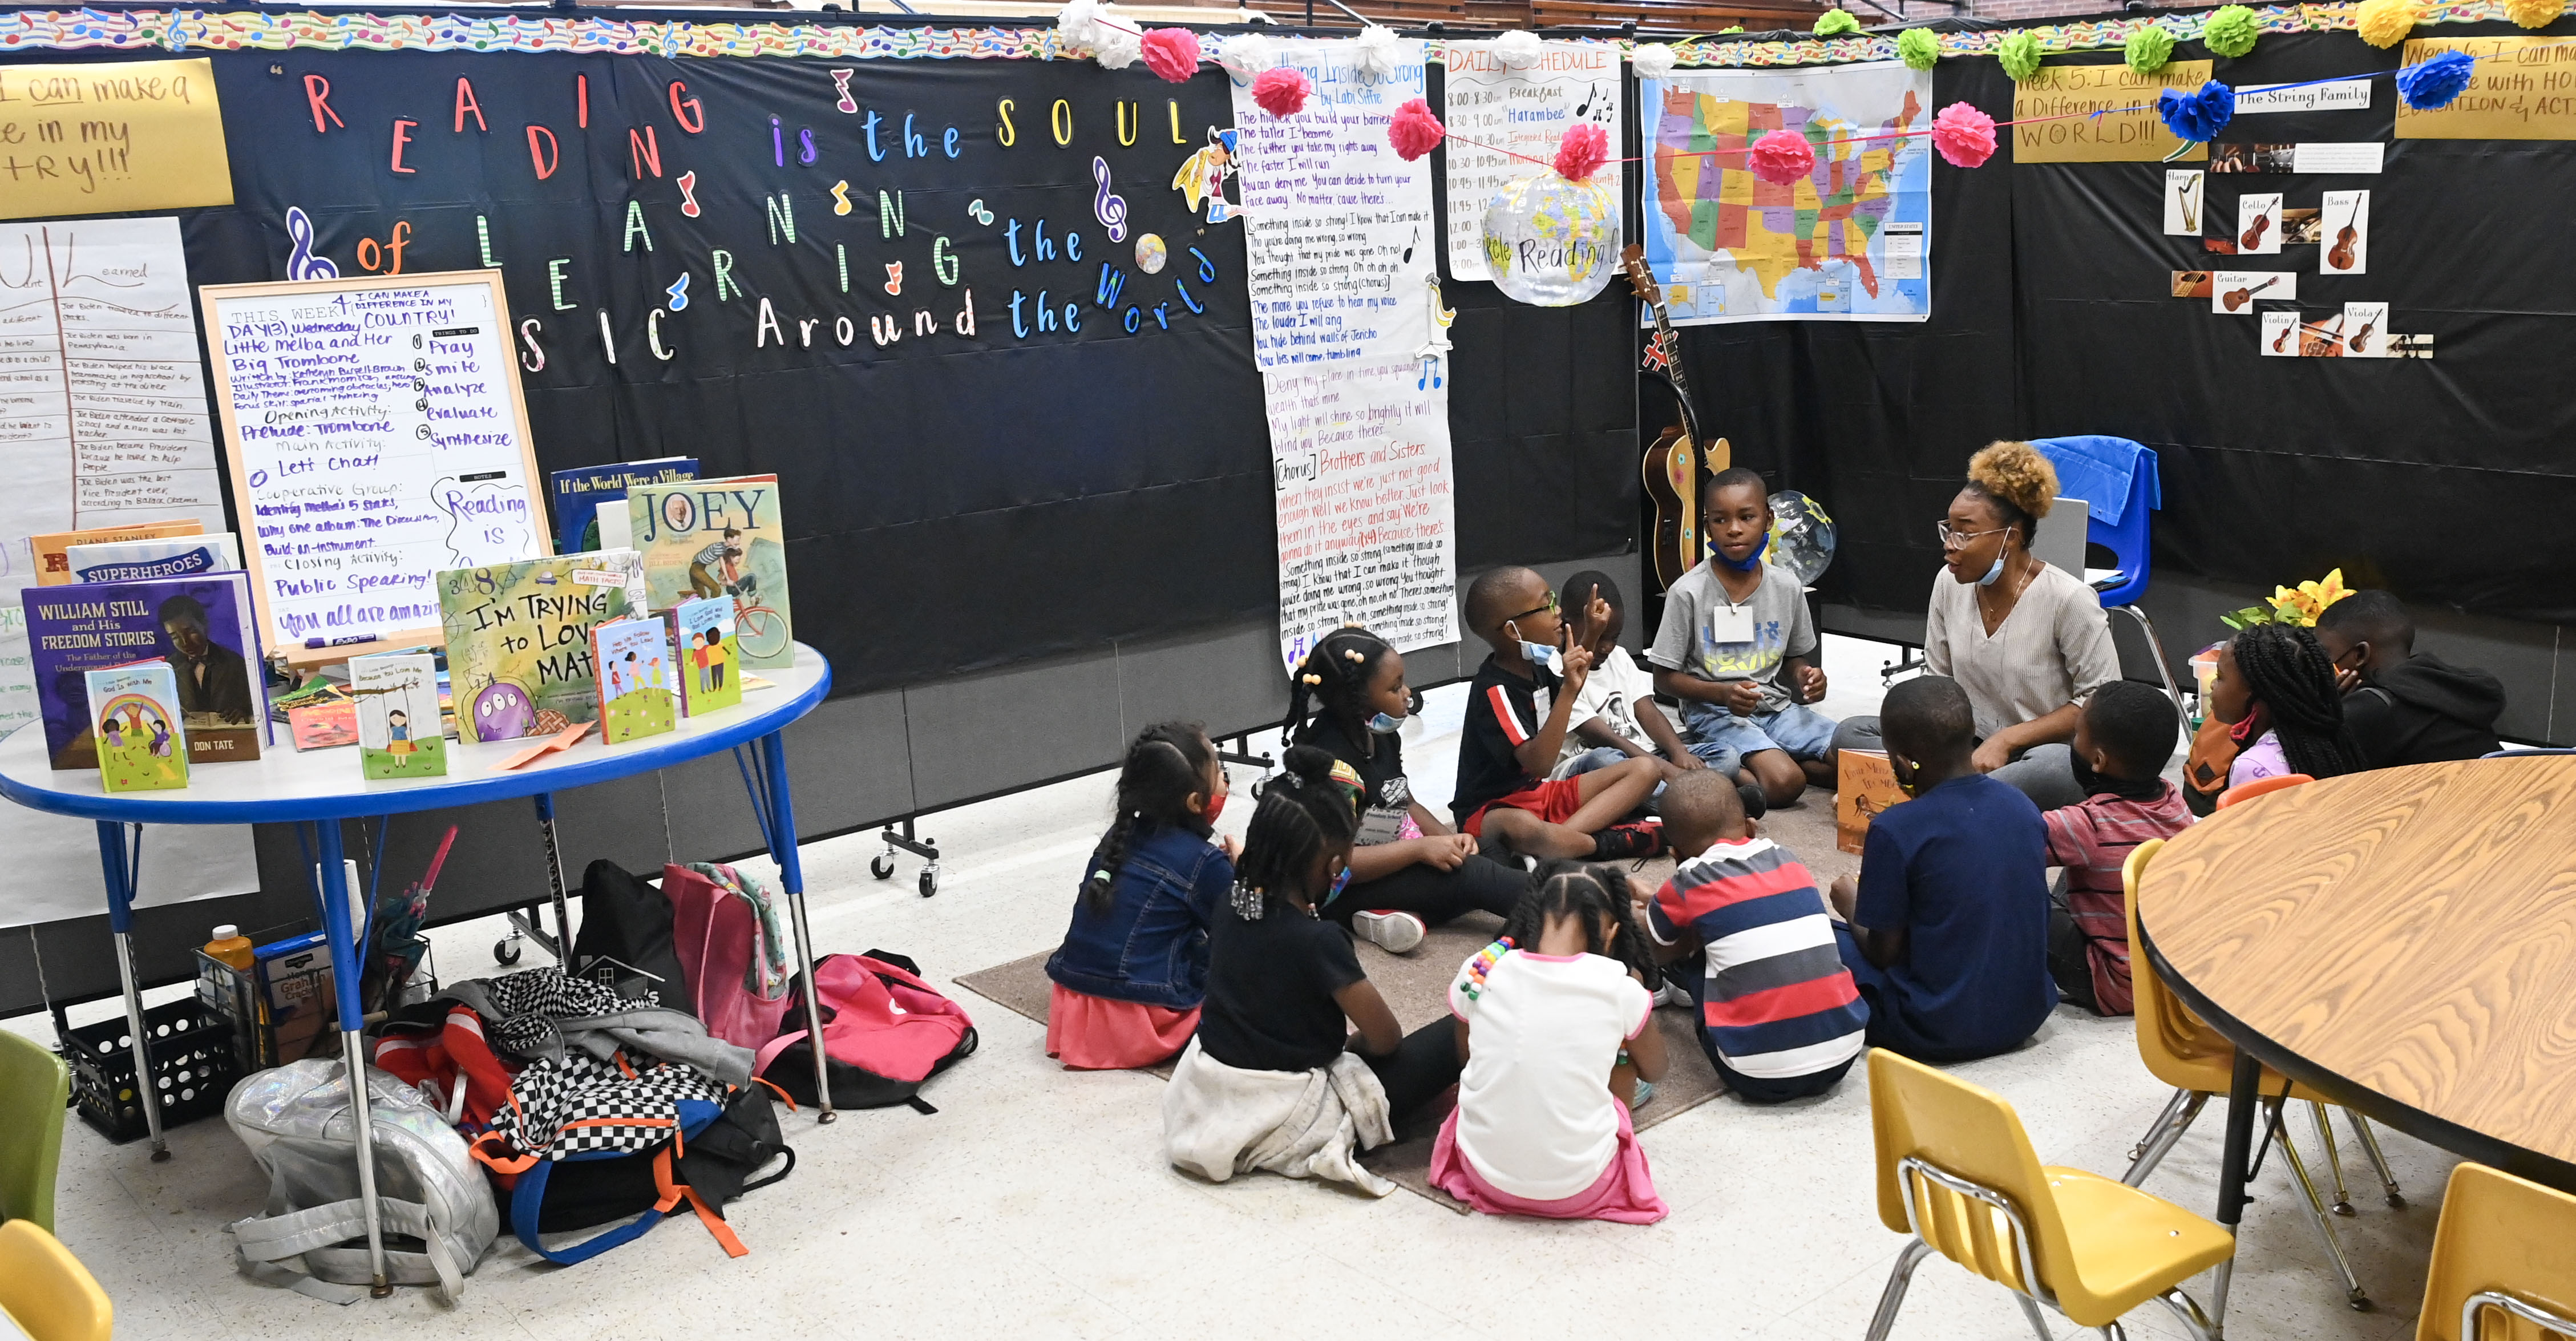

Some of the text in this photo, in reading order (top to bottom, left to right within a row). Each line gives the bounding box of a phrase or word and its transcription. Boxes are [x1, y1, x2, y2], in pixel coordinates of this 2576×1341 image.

[1510, 51, 1607, 72] HEDULE
[2517, 45, 2550, 63] can
[2158, 68, 2206, 88] make
[2488, 72, 2533, 91] with
[29, 76, 189, 104] can make a
[1510, 86, 1564, 103] Breakfast
[2239, 87, 2368, 108] The String Family
[1320, 89, 1332, 112] by
[2015, 100, 2024, 117] a
[2126, 97, 2141, 116] in
[38, 120, 63, 143] in
[81, 120, 129, 156] my
[772, 118, 818, 167] is
[862, 110, 960, 162] the
[998, 99, 1187, 147] SOUL
[1238, 128, 1256, 139] The
[1261, 159, 1284, 172] faster
[1316, 161, 1330, 170] run
[2167, 172, 2189, 186] Harp
[2242, 200, 2266, 210] Cello
[2327, 196, 2349, 206] Bass
[357, 221, 411, 276] of
[1004, 218, 1082, 266] the
[1519, 239, 1605, 278] Reading
[2217, 273, 2247, 284] Guitar
[355, 300, 417, 309] DIFFERENCE
[1272, 301, 1292, 312] more
[1296, 301, 1309, 316] you
[1312, 297, 1334, 310] refuse
[1348, 296, 1364, 307] hear
[1367, 298, 1378, 313] my
[1381, 297, 1397, 306] voice
[2347, 308, 2373, 318] Viola
[232, 306, 339, 324] THIS WEEK
[757, 288, 974, 347] Around
[1008, 290, 1081, 338] the
[2263, 314, 2289, 325] Violin
[224, 339, 269, 355] Little
[329, 335, 362, 348] and
[365, 333, 393, 345] Her
[1291, 332, 1316, 346] behind
[429, 341, 474, 358] Pray
[232, 354, 359, 376] Big Trombone
[424, 382, 487, 397] Analyze
[265, 407, 327, 425] Opening
[427, 406, 497, 421] evaluate
[1320, 449, 1365, 476] Brothers
[1370, 446, 1386, 463] and
[560, 468, 694, 494] If the World Were Village
[446, 490, 527, 522] Reading
[641, 490, 766, 542] JOEY
[113, 534, 156, 542] STANLEY
[87, 553, 203, 583] SUPERHEROES
[285, 557, 341, 570] Closing
[274, 578, 337, 597] Public
[38, 600, 149, 620] WILLIAM STILL
[518, 593, 608, 622] TRYING
[99, 620, 120, 630] His
[41, 631, 156, 650] FREEDOM STORIES
[500, 636, 529, 653] to
[84, 653, 111, 662] Father
[194, 740, 234, 752] DON TATE
